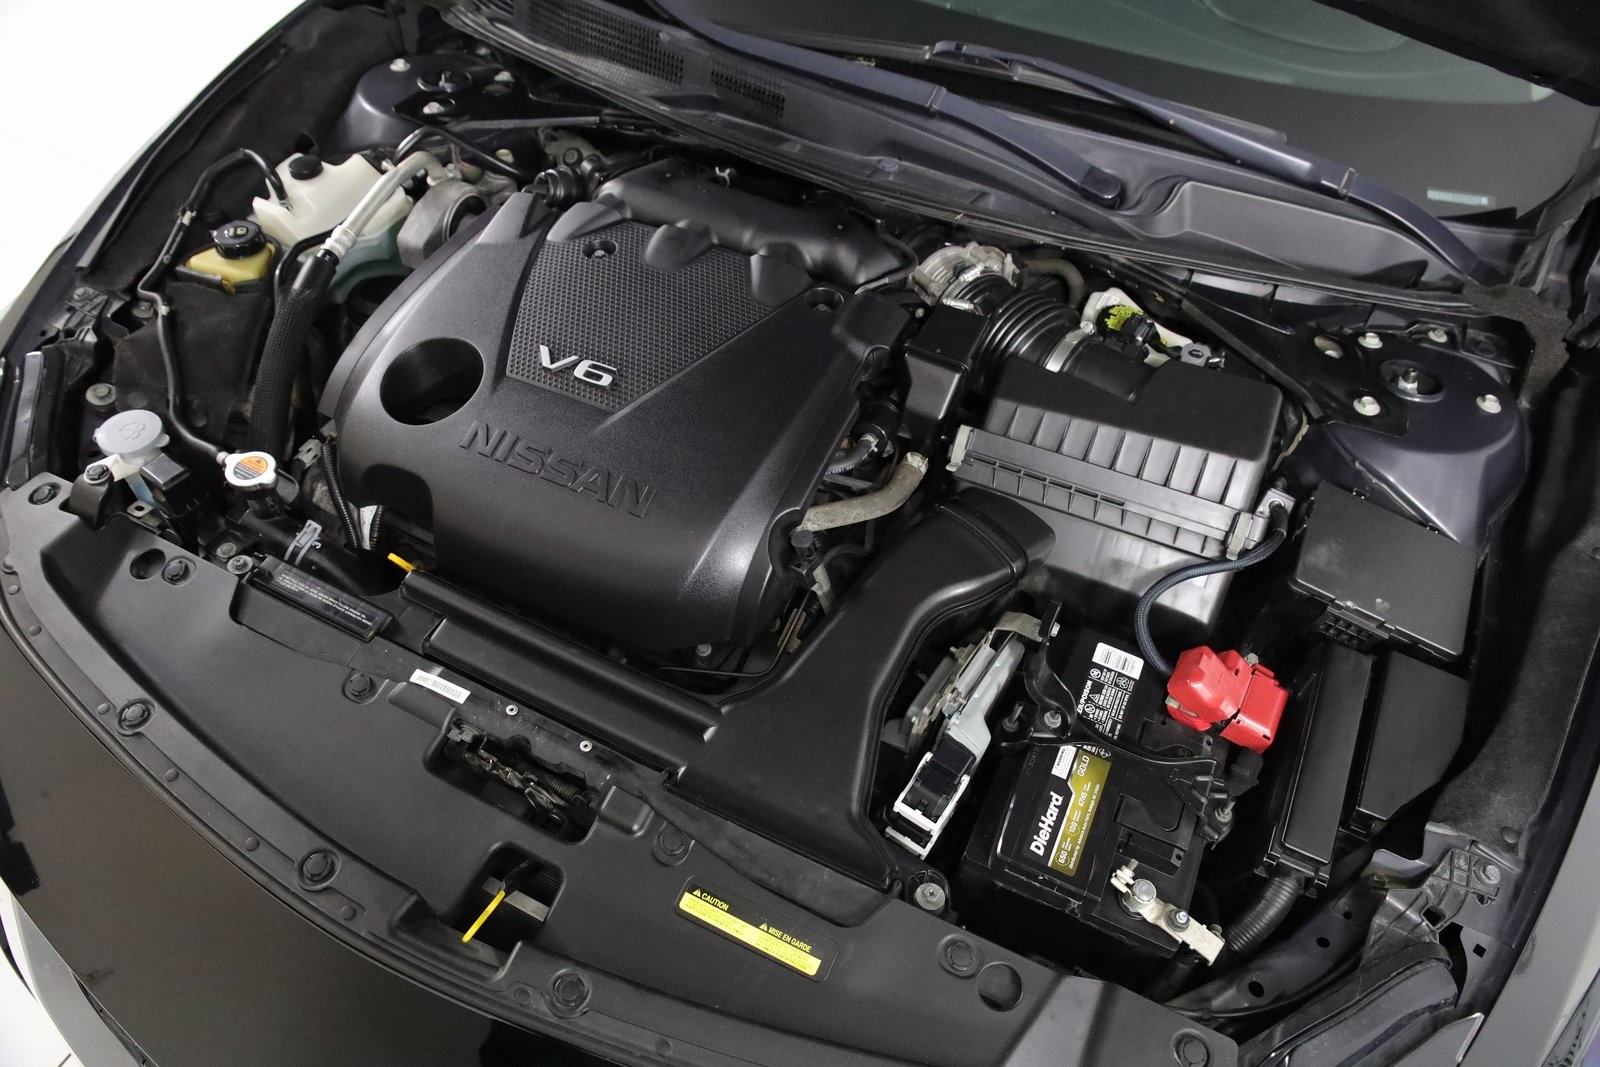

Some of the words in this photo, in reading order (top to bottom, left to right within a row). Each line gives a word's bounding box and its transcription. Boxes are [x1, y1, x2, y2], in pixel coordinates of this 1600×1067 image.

[540, 344, 618, 387] V6
[459, 419, 657, 519] NISSAN
[1077, 755, 1090, 777] GOLD
[1030, 790, 1064, 856] DieHard
[1068, 822, 1078, 833] 100
[701, 893, 729, 911] CAUTION
[768, 926, 782, 939] MISE
[782, 934, 792, 943] EN
[791, 938, 812, 953] GARDE
